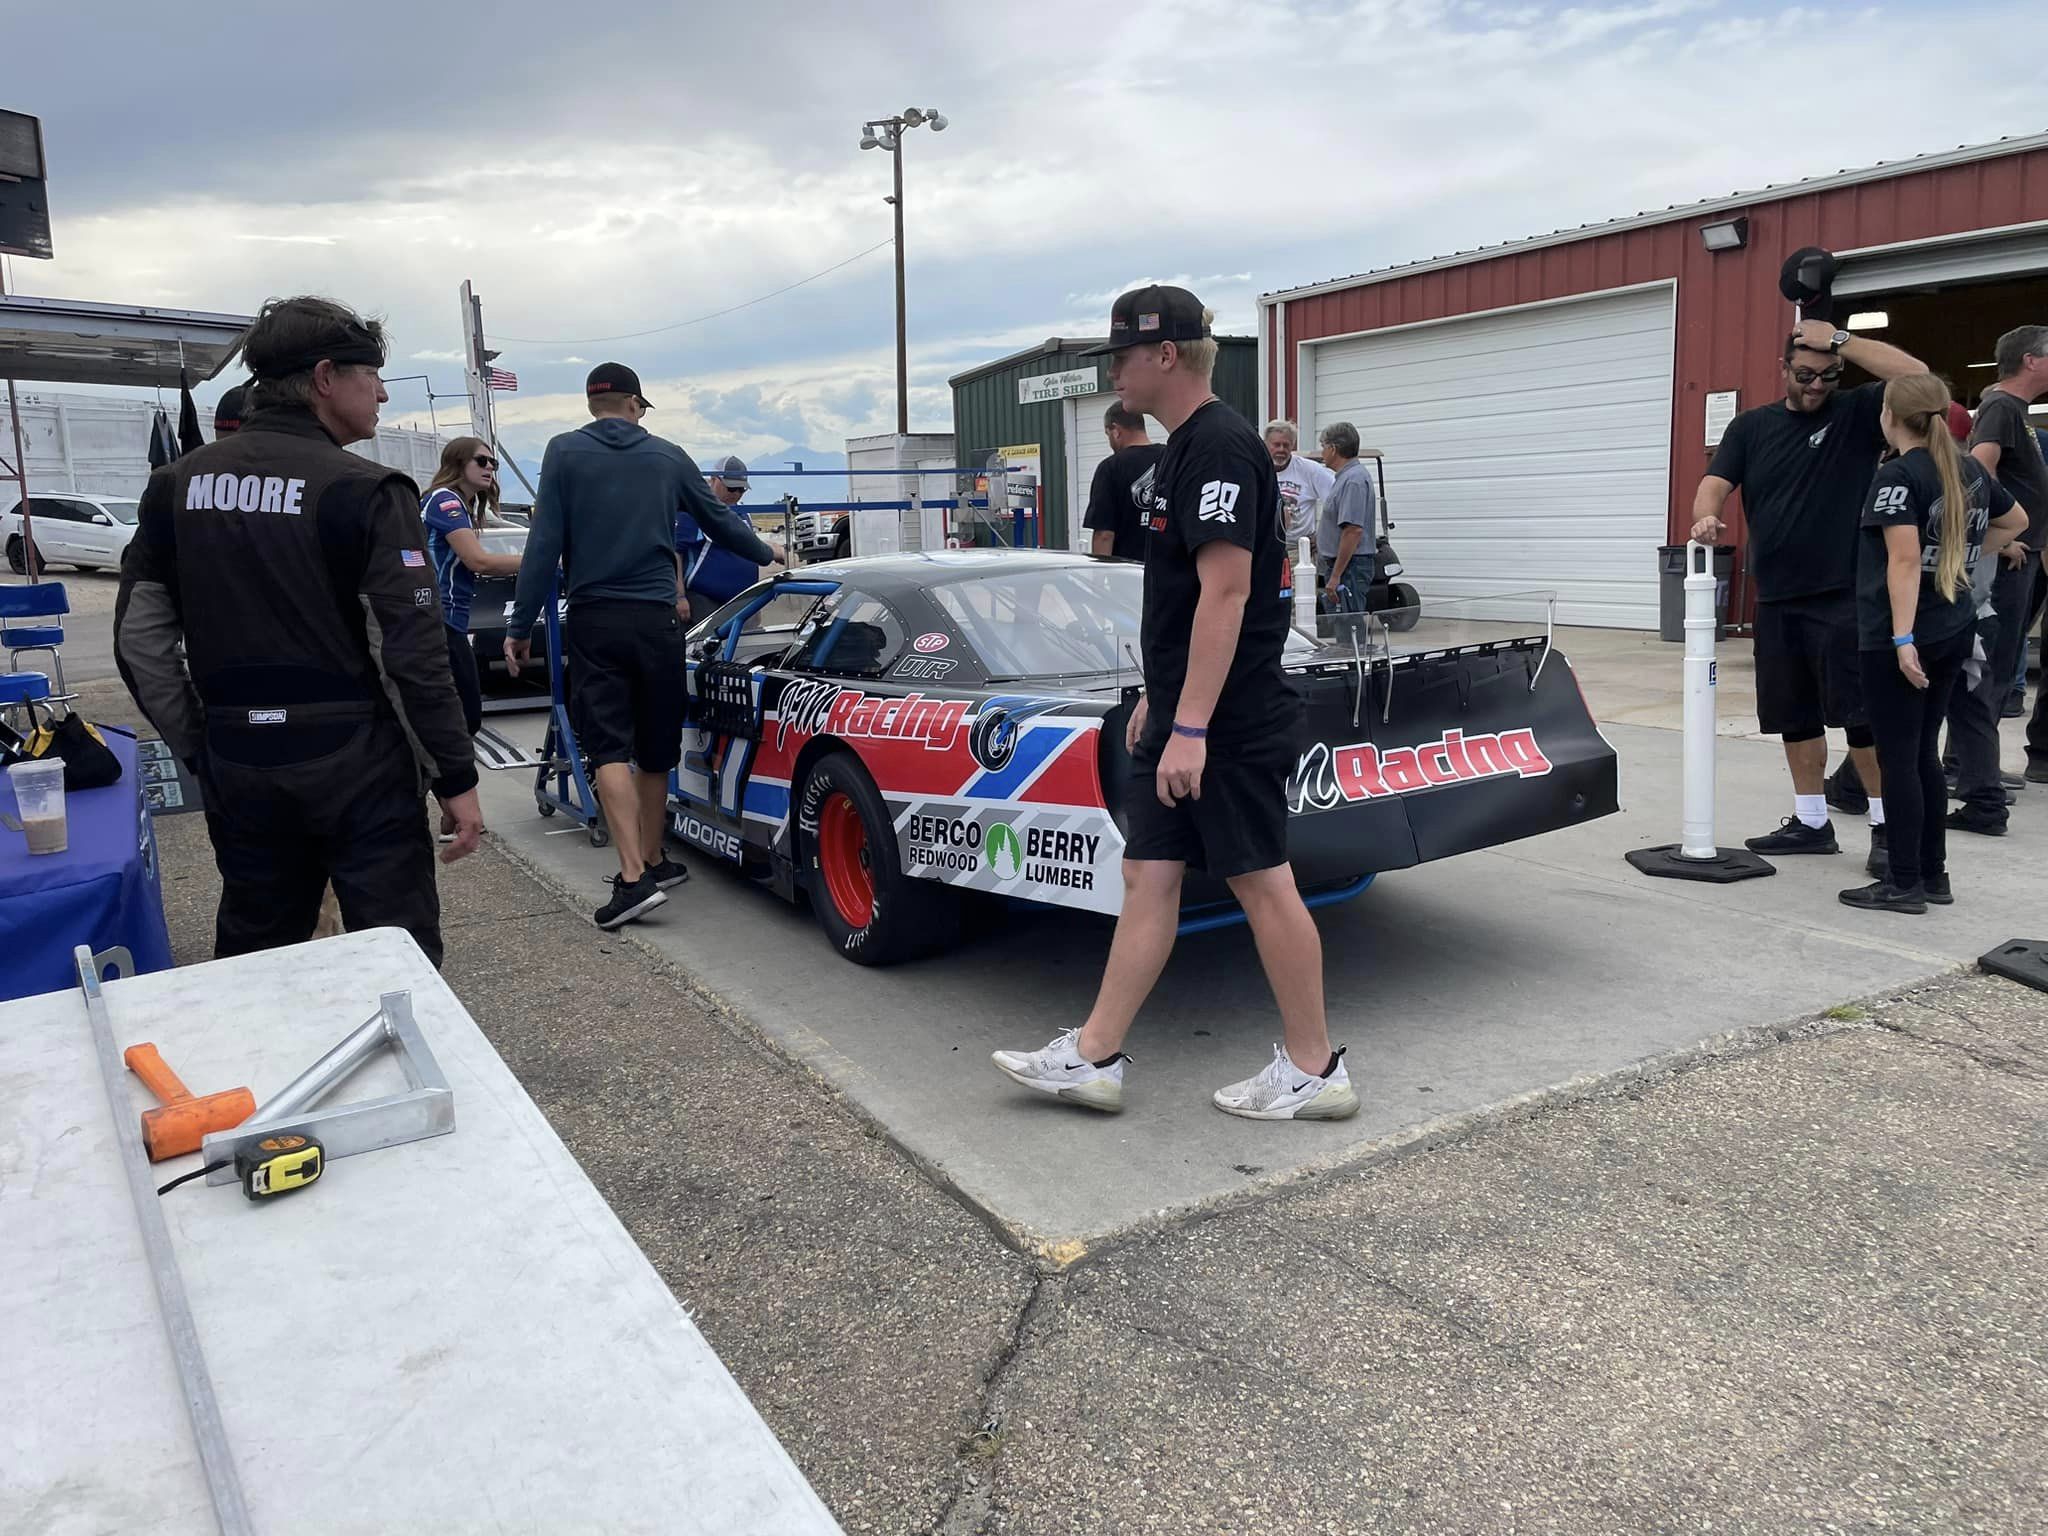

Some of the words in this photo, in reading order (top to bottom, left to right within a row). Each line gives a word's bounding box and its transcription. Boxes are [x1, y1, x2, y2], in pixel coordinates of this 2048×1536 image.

[1032, 387, 1059, 400] TIRE
[1063, 382, 1096, 396] SHED
[186, 473, 306, 515] MOORE
[1199, 480, 1240, 515] 20
[1874, 486, 1909, 507] 20
[414, 588, 432, 606] 27
[917, 634, 944, 649] STP
[825, 690, 974, 751] Racing
[1333, 727, 1553, 802] Racing
[674, 812, 741, 857] MOORE
[910, 813, 983, 849] BERCO
[1026, 827, 1101, 864] BERRY
[909, 846, 979, 872] REDWOOD
[1025, 862, 1094, 890] LUMBER
